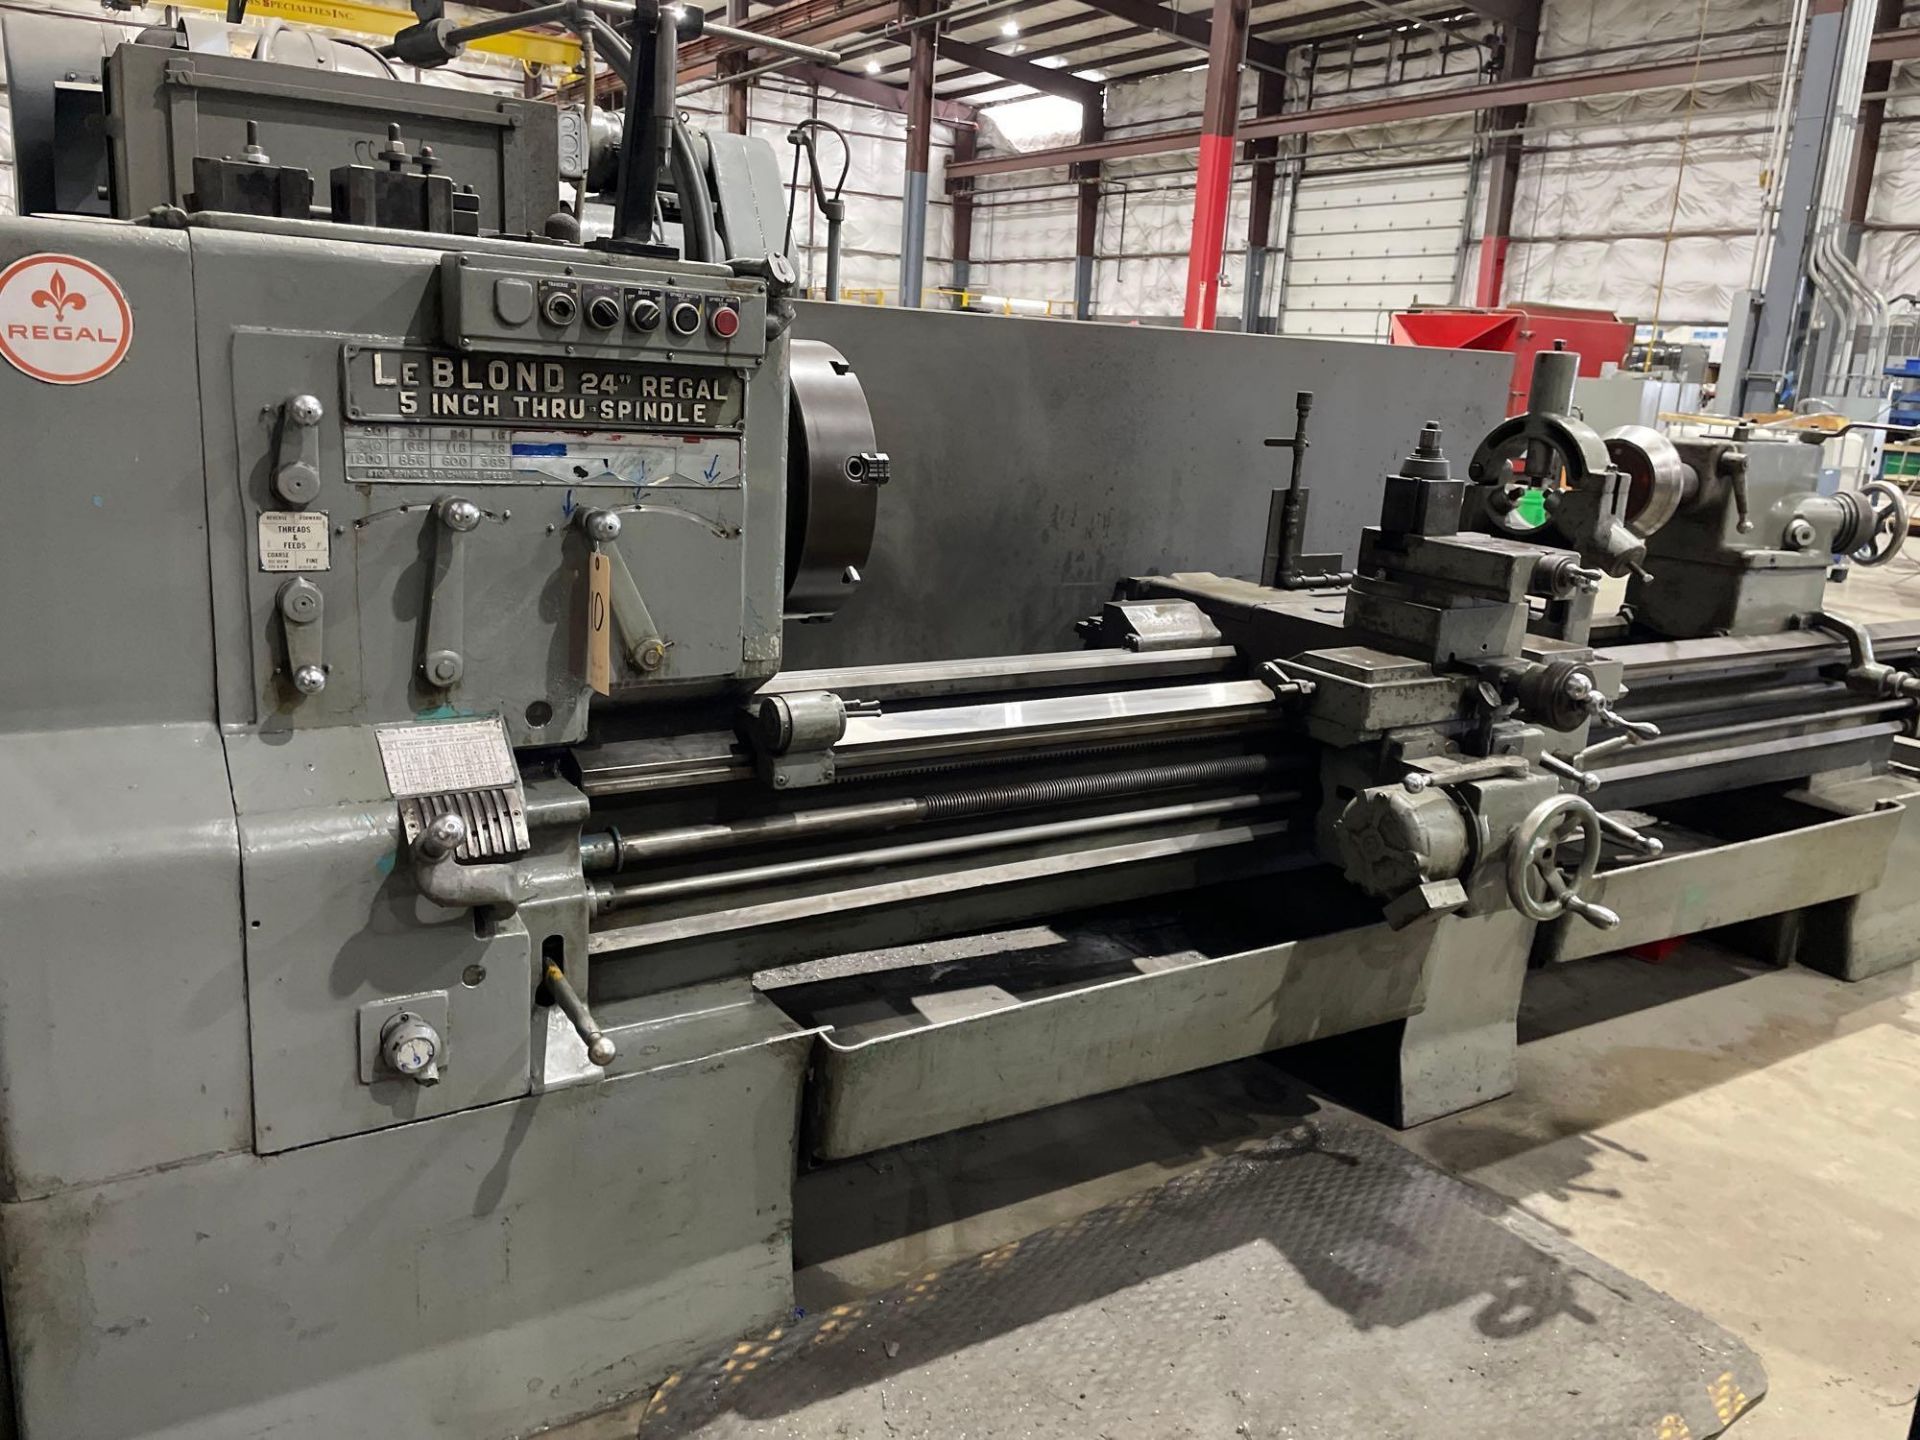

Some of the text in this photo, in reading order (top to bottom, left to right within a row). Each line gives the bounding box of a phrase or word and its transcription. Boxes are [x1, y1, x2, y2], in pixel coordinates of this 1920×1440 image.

[8, 323, 117, 344] REGAL
[641, 375, 728, 401] REGAL
[399, 391, 418, 415] 5
[432, 393, 500, 417] INCH
[350, 453, 384, 465] 1200
[278, 525, 311, 533] THREADS
[590, 591, 604, 632] 10
